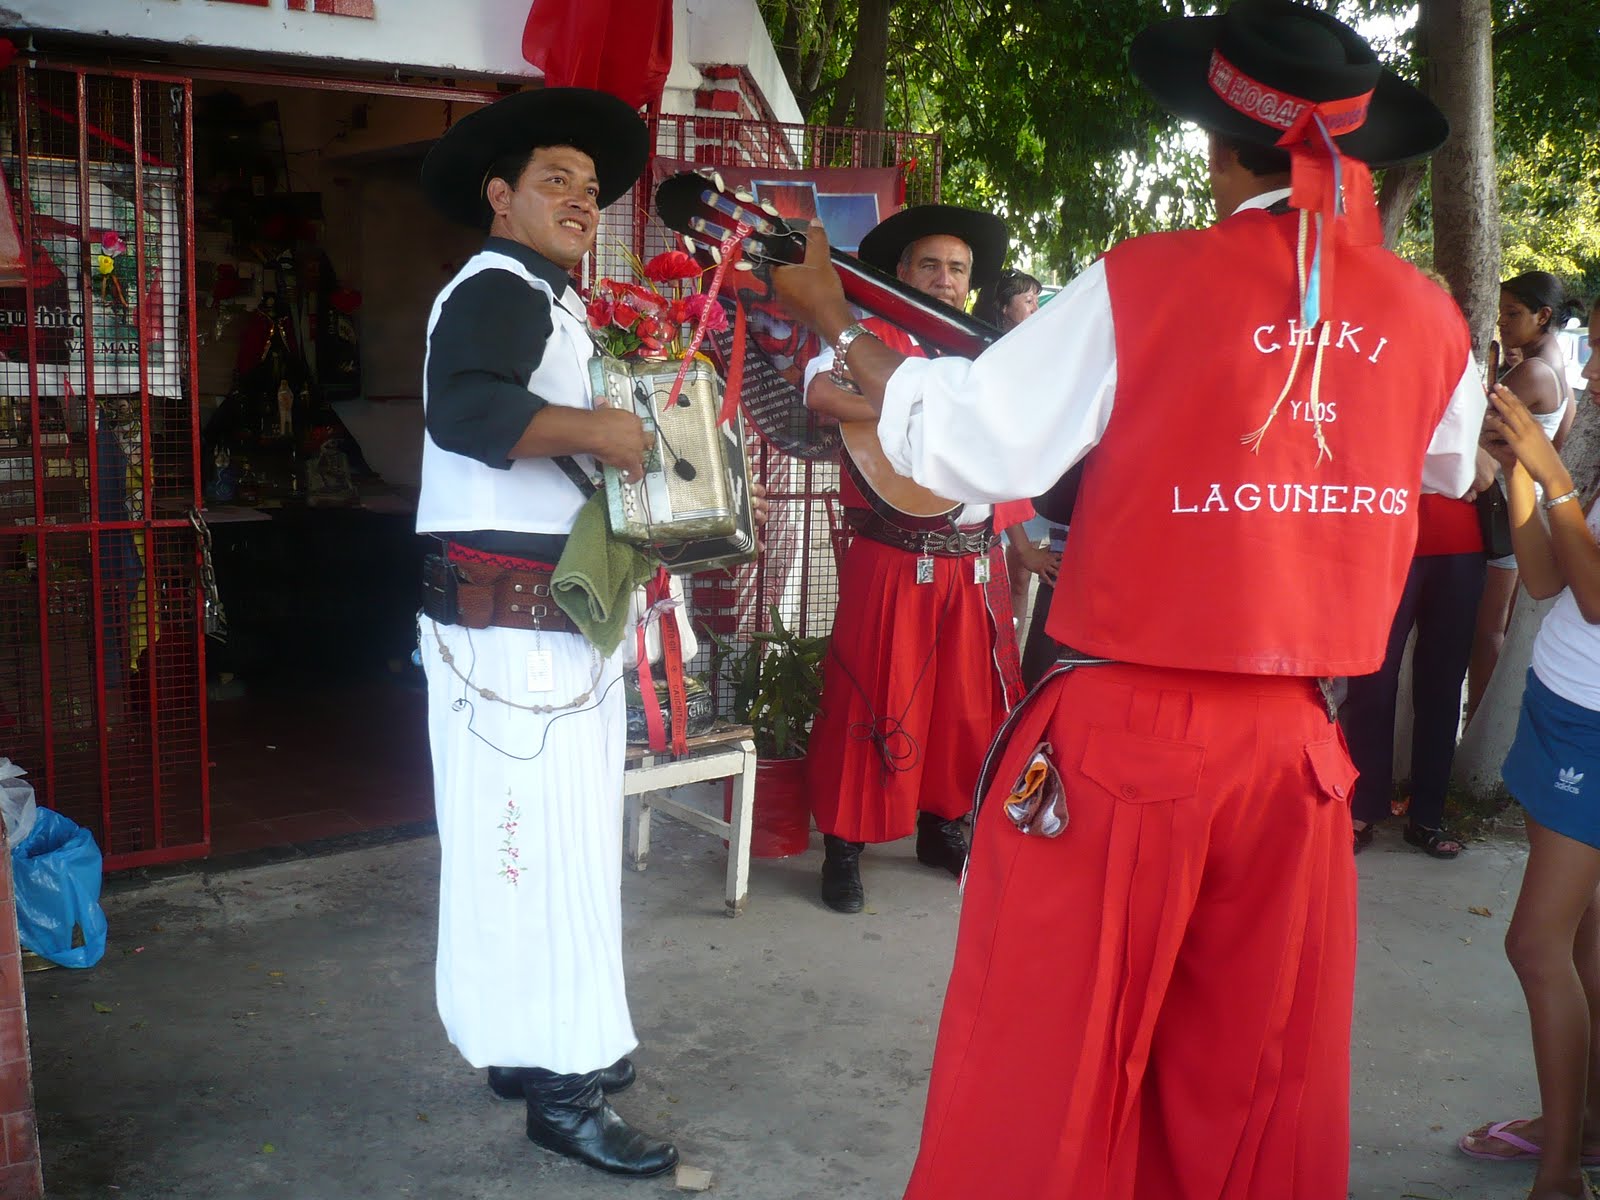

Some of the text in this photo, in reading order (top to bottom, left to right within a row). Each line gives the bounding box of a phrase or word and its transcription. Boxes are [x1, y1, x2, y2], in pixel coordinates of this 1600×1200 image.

[0, 305, 84, 328] auhito
[66, 340, 139, 353] VMAR
[687, 325, 705, 357] VIAJE
[1172, 483, 1409, 515] LAGUNEROS
[1554, 782, 1580, 794] adidas
